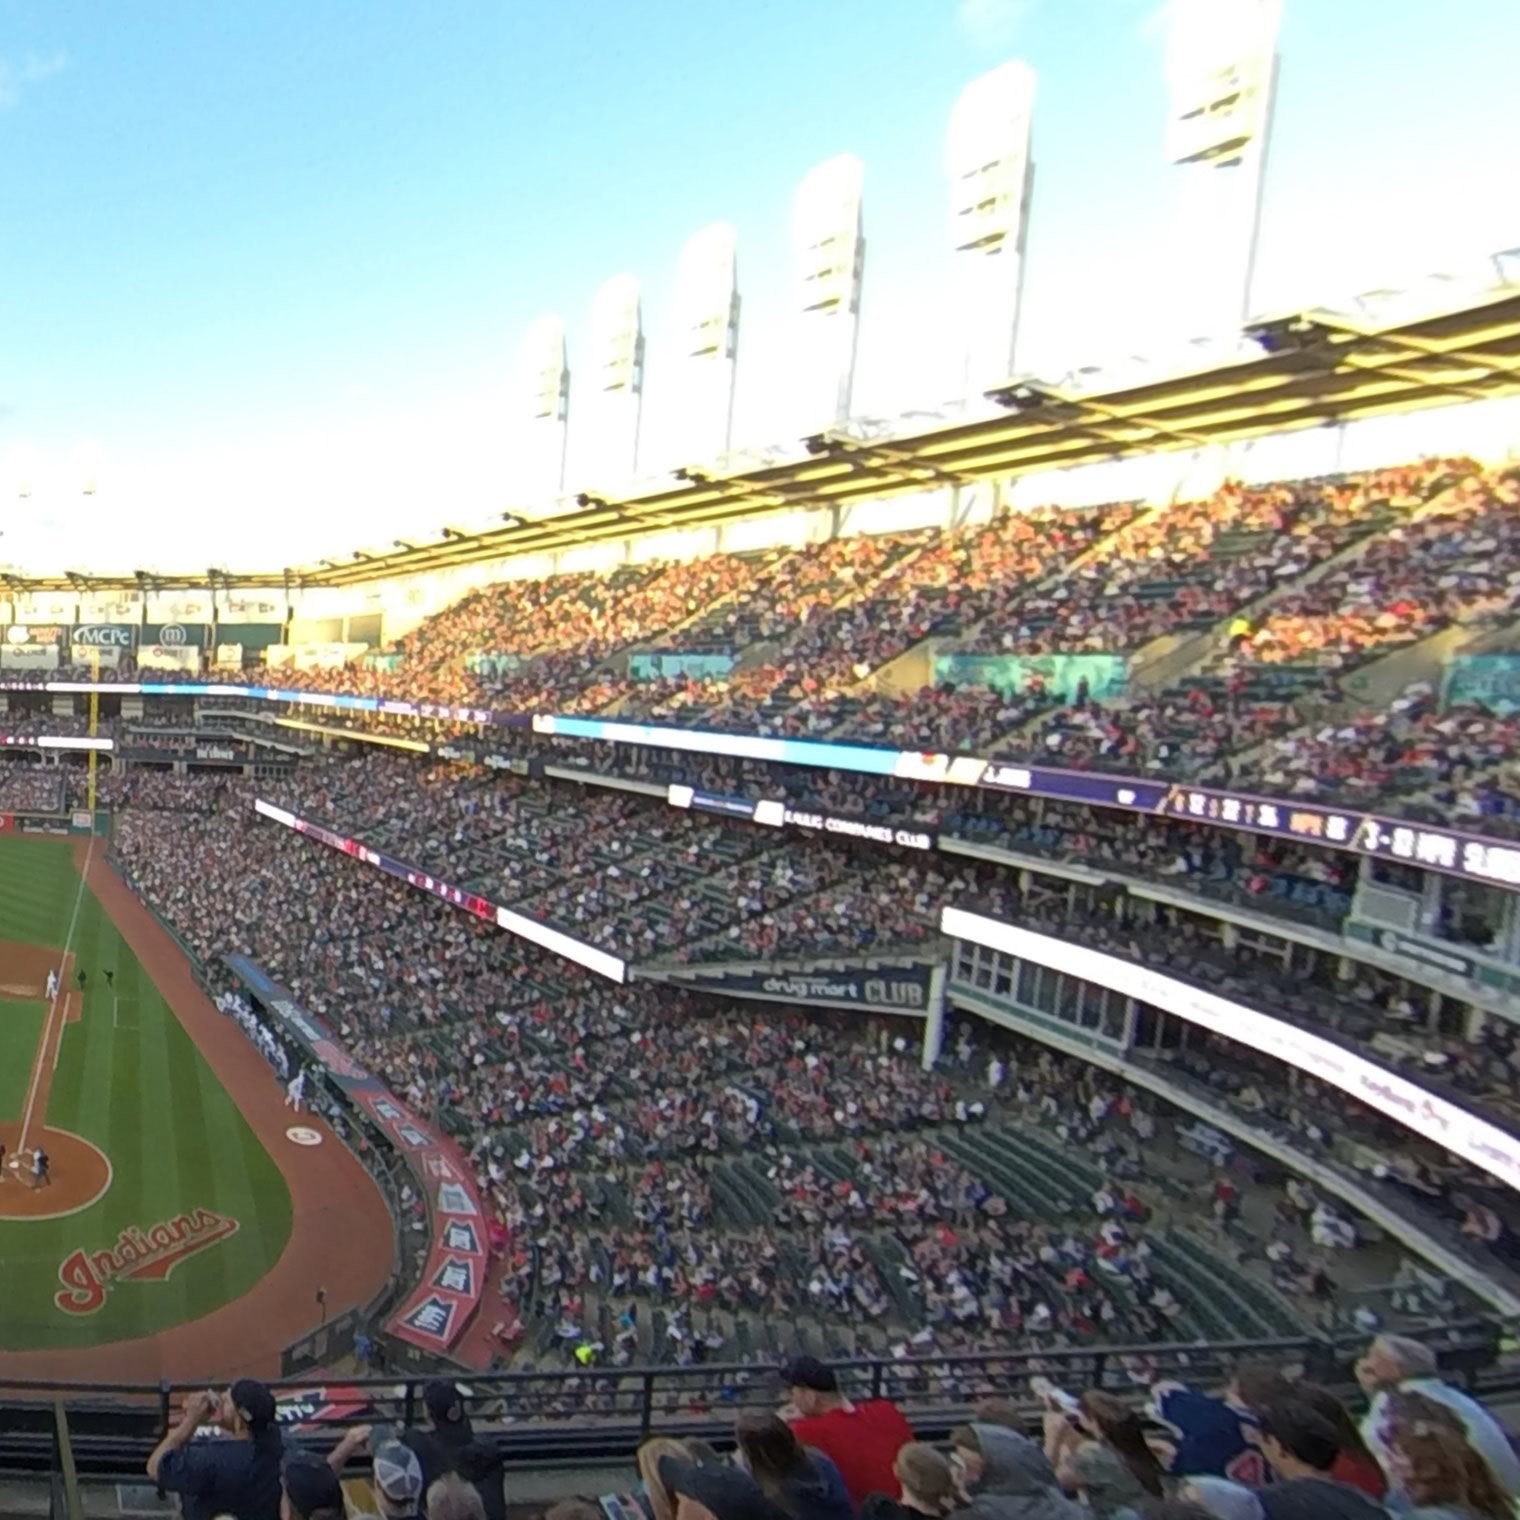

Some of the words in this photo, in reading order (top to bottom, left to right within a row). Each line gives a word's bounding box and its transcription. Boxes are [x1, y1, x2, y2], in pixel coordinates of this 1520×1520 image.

[762, 977, 808, 998] drug
[811, 982, 858, 999] mart
[864, 979, 923, 1006] CLUB
[55, 1208, 240, 1315] Indians
